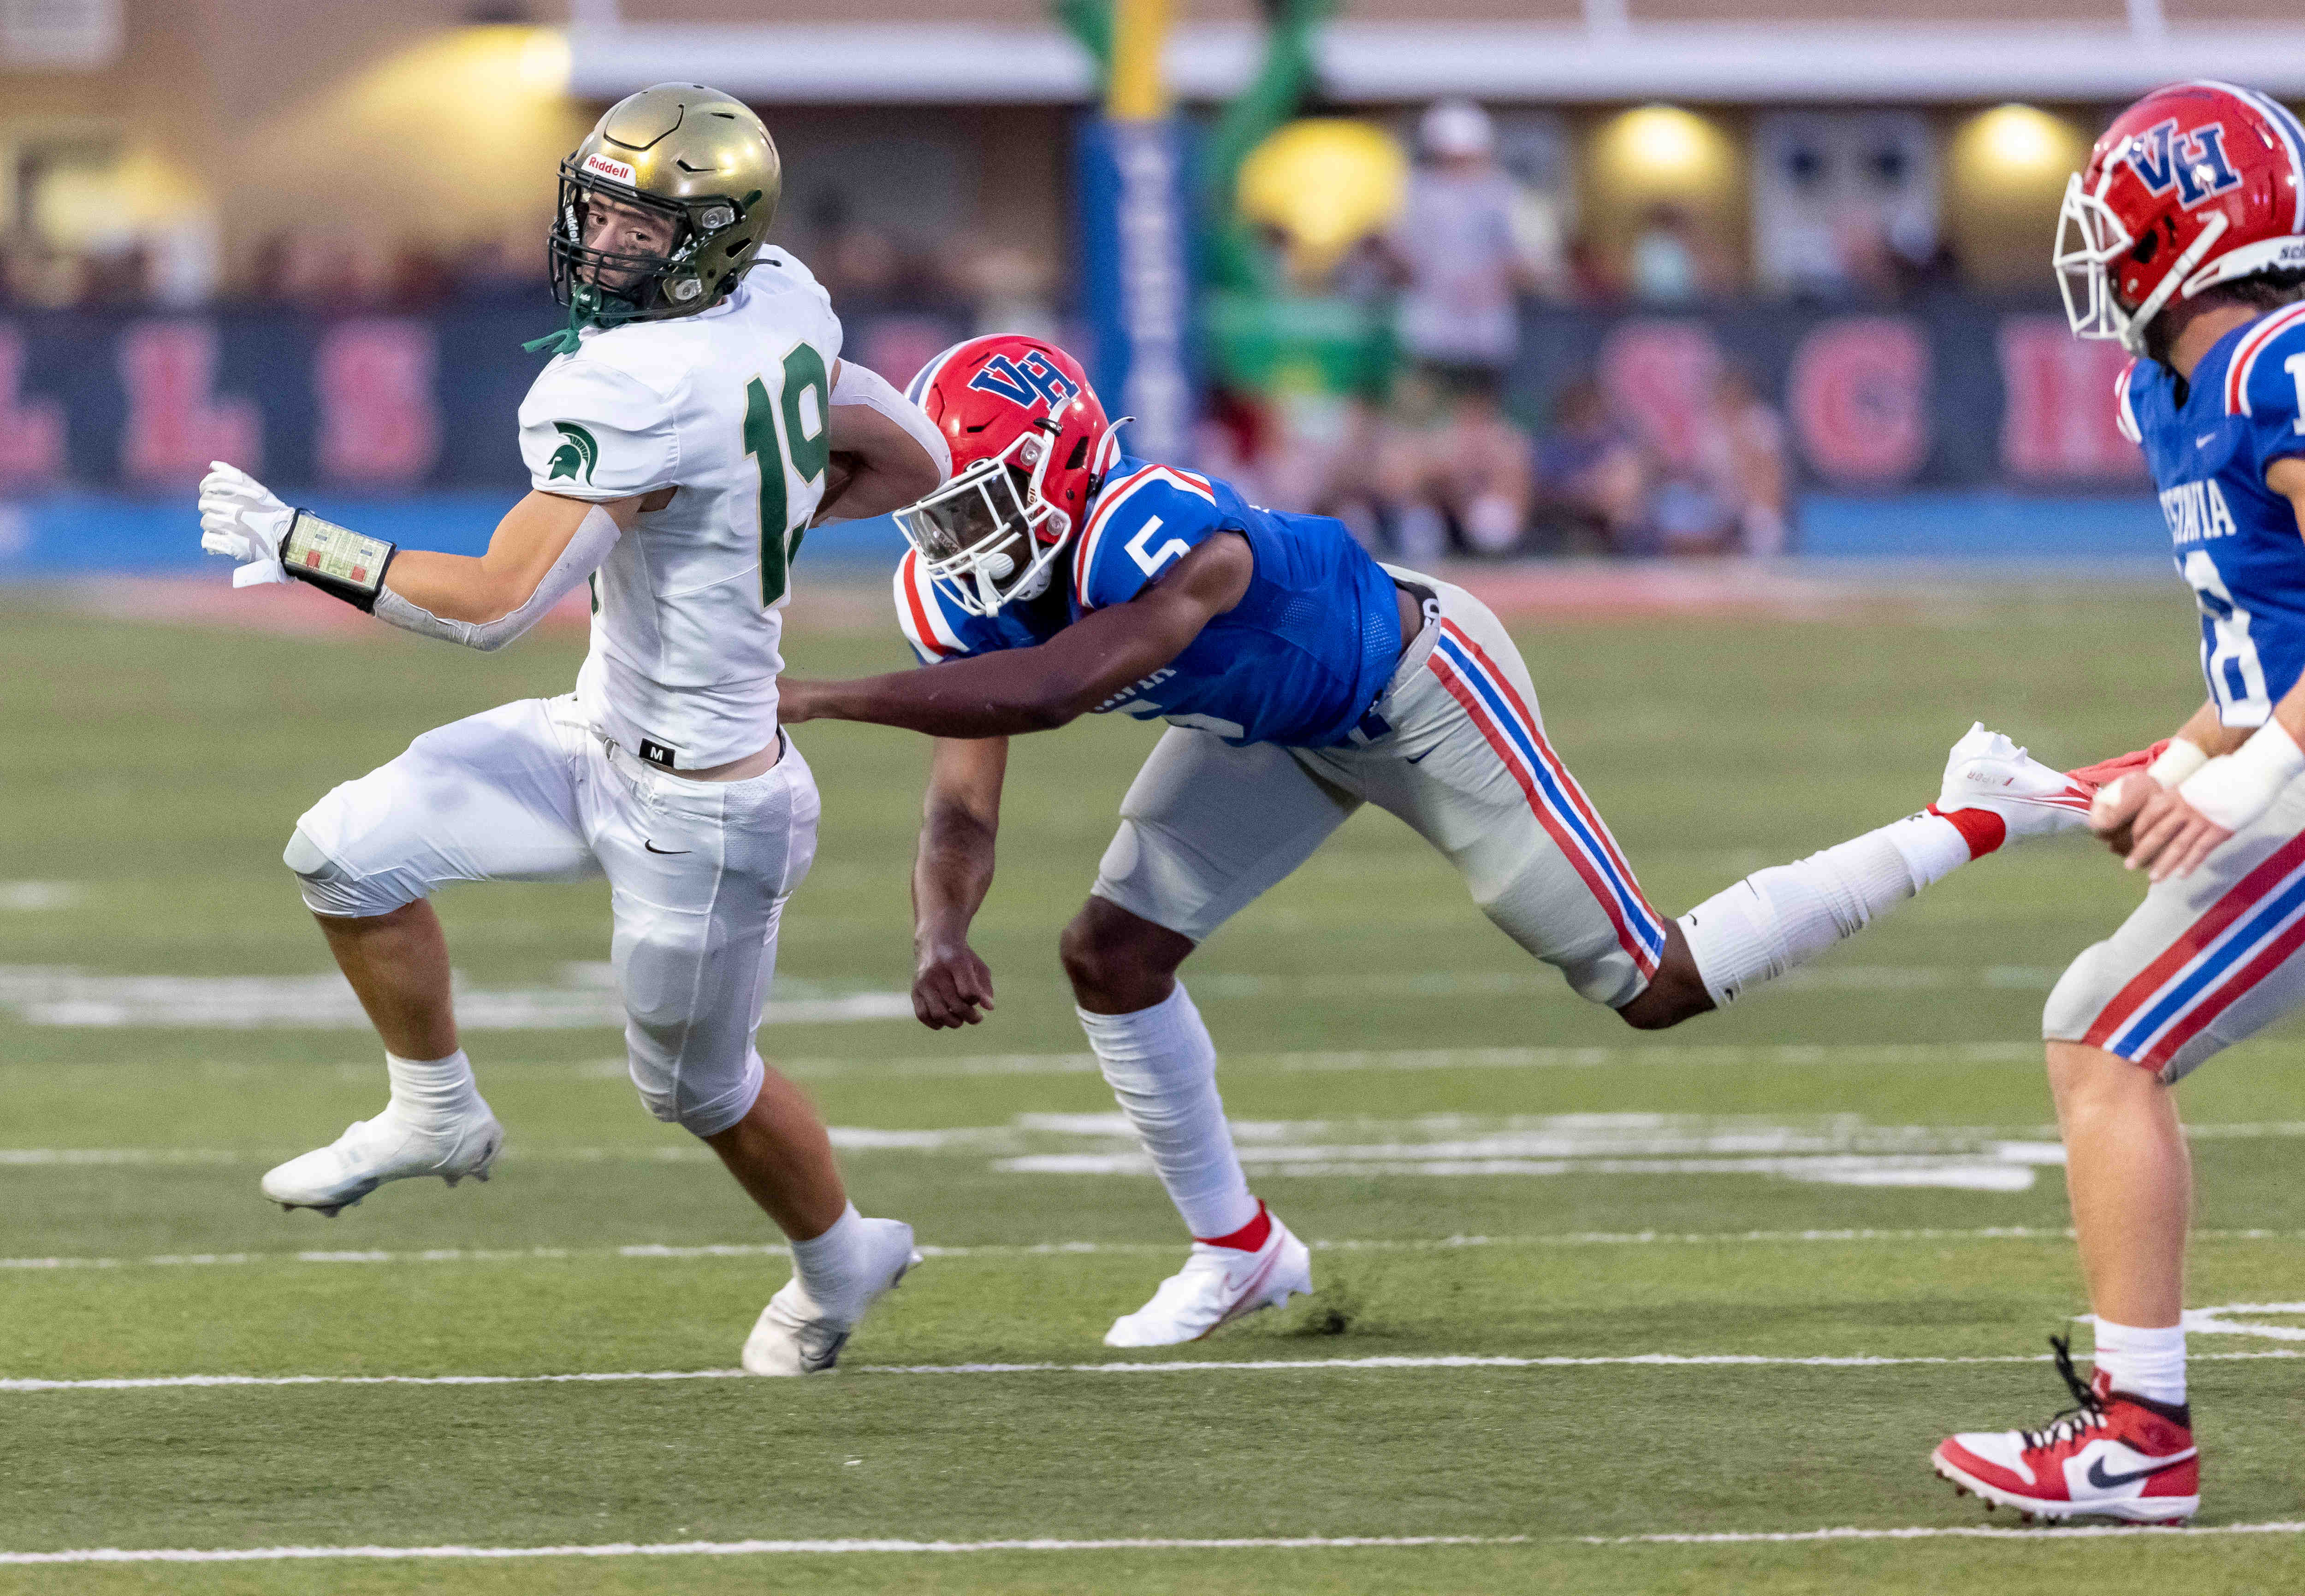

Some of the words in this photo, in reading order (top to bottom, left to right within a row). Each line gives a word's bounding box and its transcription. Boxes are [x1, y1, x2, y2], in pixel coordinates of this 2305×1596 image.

[588, 156, 629, 179] Riddell
[2127, 117, 2243, 211] VH
[967, 349, 1082, 410] VH
[741, 338, 830, 611] 19
[1123, 514, 1191, 578] 5
[650, 746, 664, 762] M
